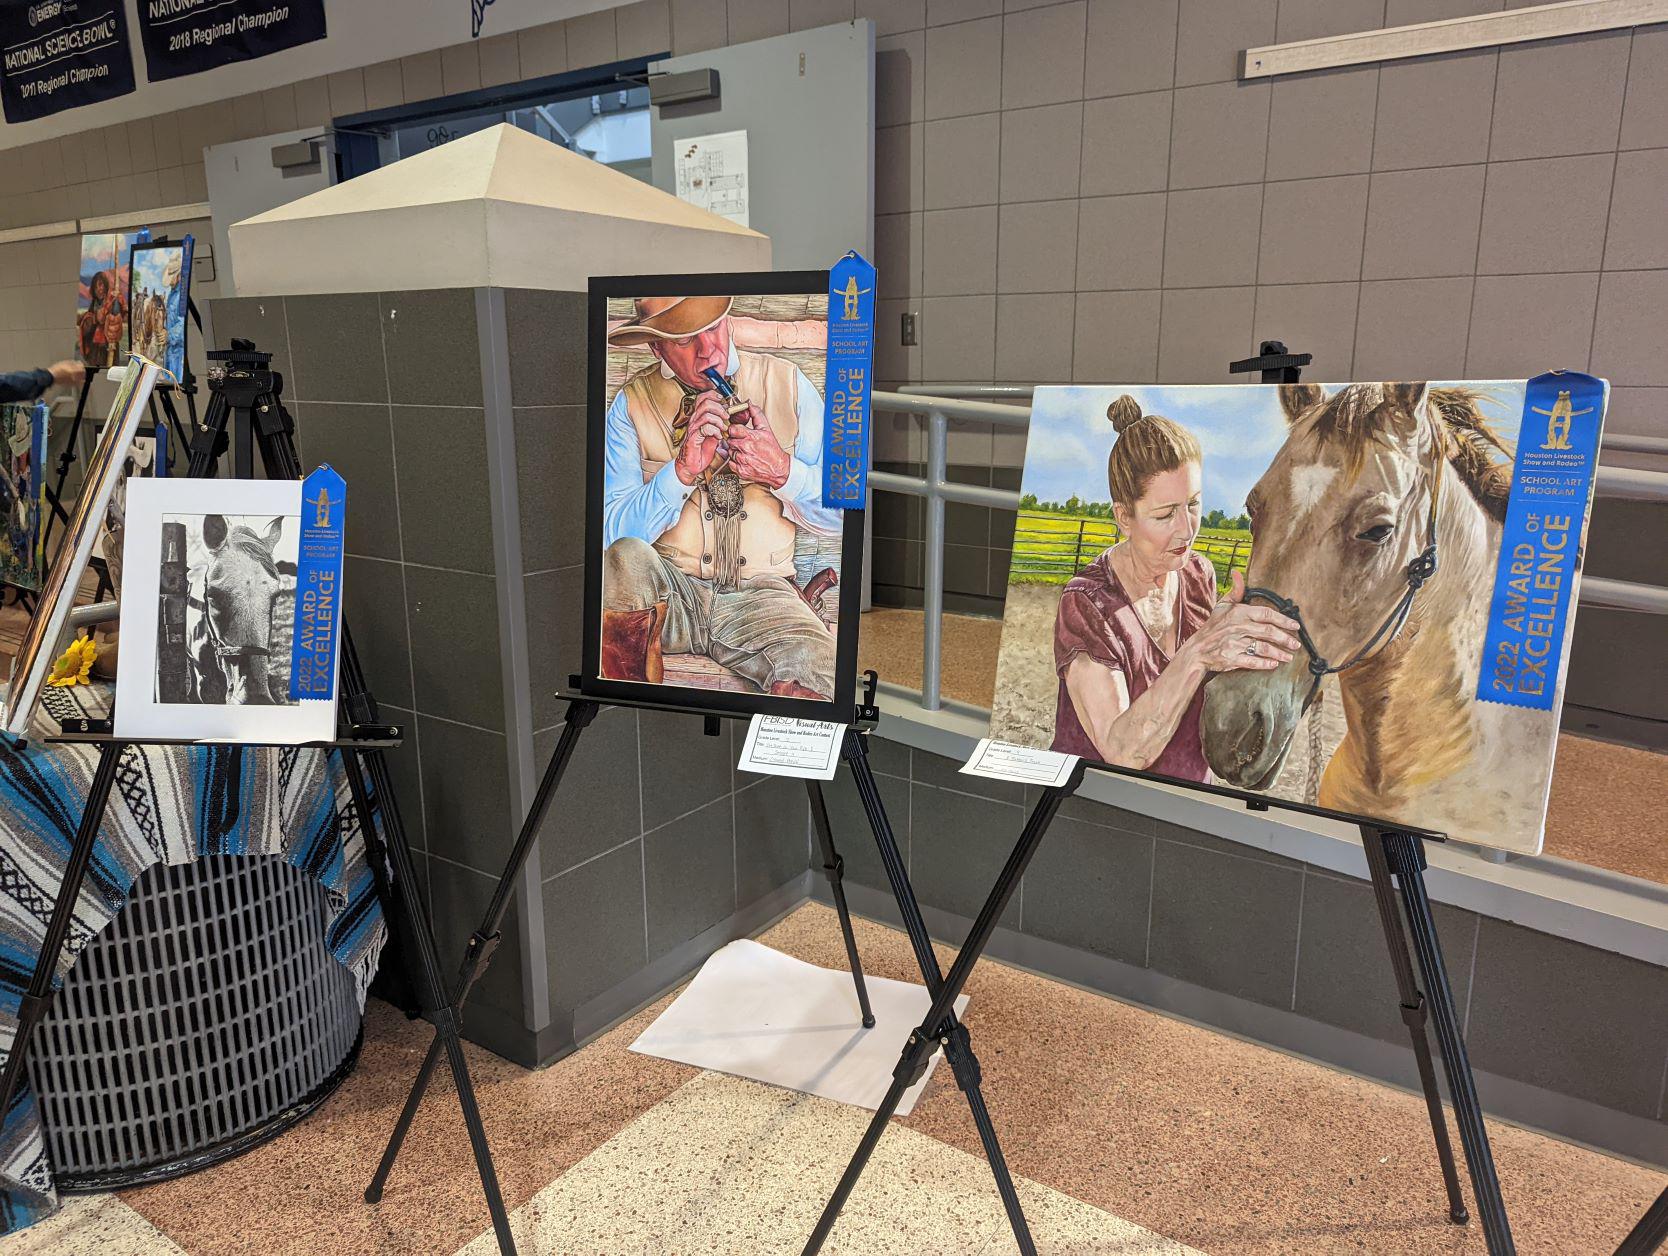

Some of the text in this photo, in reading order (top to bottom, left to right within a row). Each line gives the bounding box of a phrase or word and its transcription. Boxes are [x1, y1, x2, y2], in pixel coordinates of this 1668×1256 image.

[4, 44, 45, 70] NATIONAL
[45, 30, 83, 57] SCIENCE
[36, 3, 61, 22] ENERGY
[169, 6, 289, 51] 2018 Regional Champion
[37, 71, 68, 95] Regional
[70, 63, 109, 84] Champion
[829, 368, 847, 500] 2022 AWARD OF
[844, 368, 864, 500] EXCELLENCE
[1520, 476, 1583, 487] SCHOOL ART
[1523, 486, 1575, 496] PROGRAM
[298, 569, 318, 692] 2022 AWARD OF
[313, 570, 335, 692] EXCELLENCE
[1493, 513, 1541, 693] 2022 AWARD OF
[1517, 514, 1571, 696] EXCELLENCE
